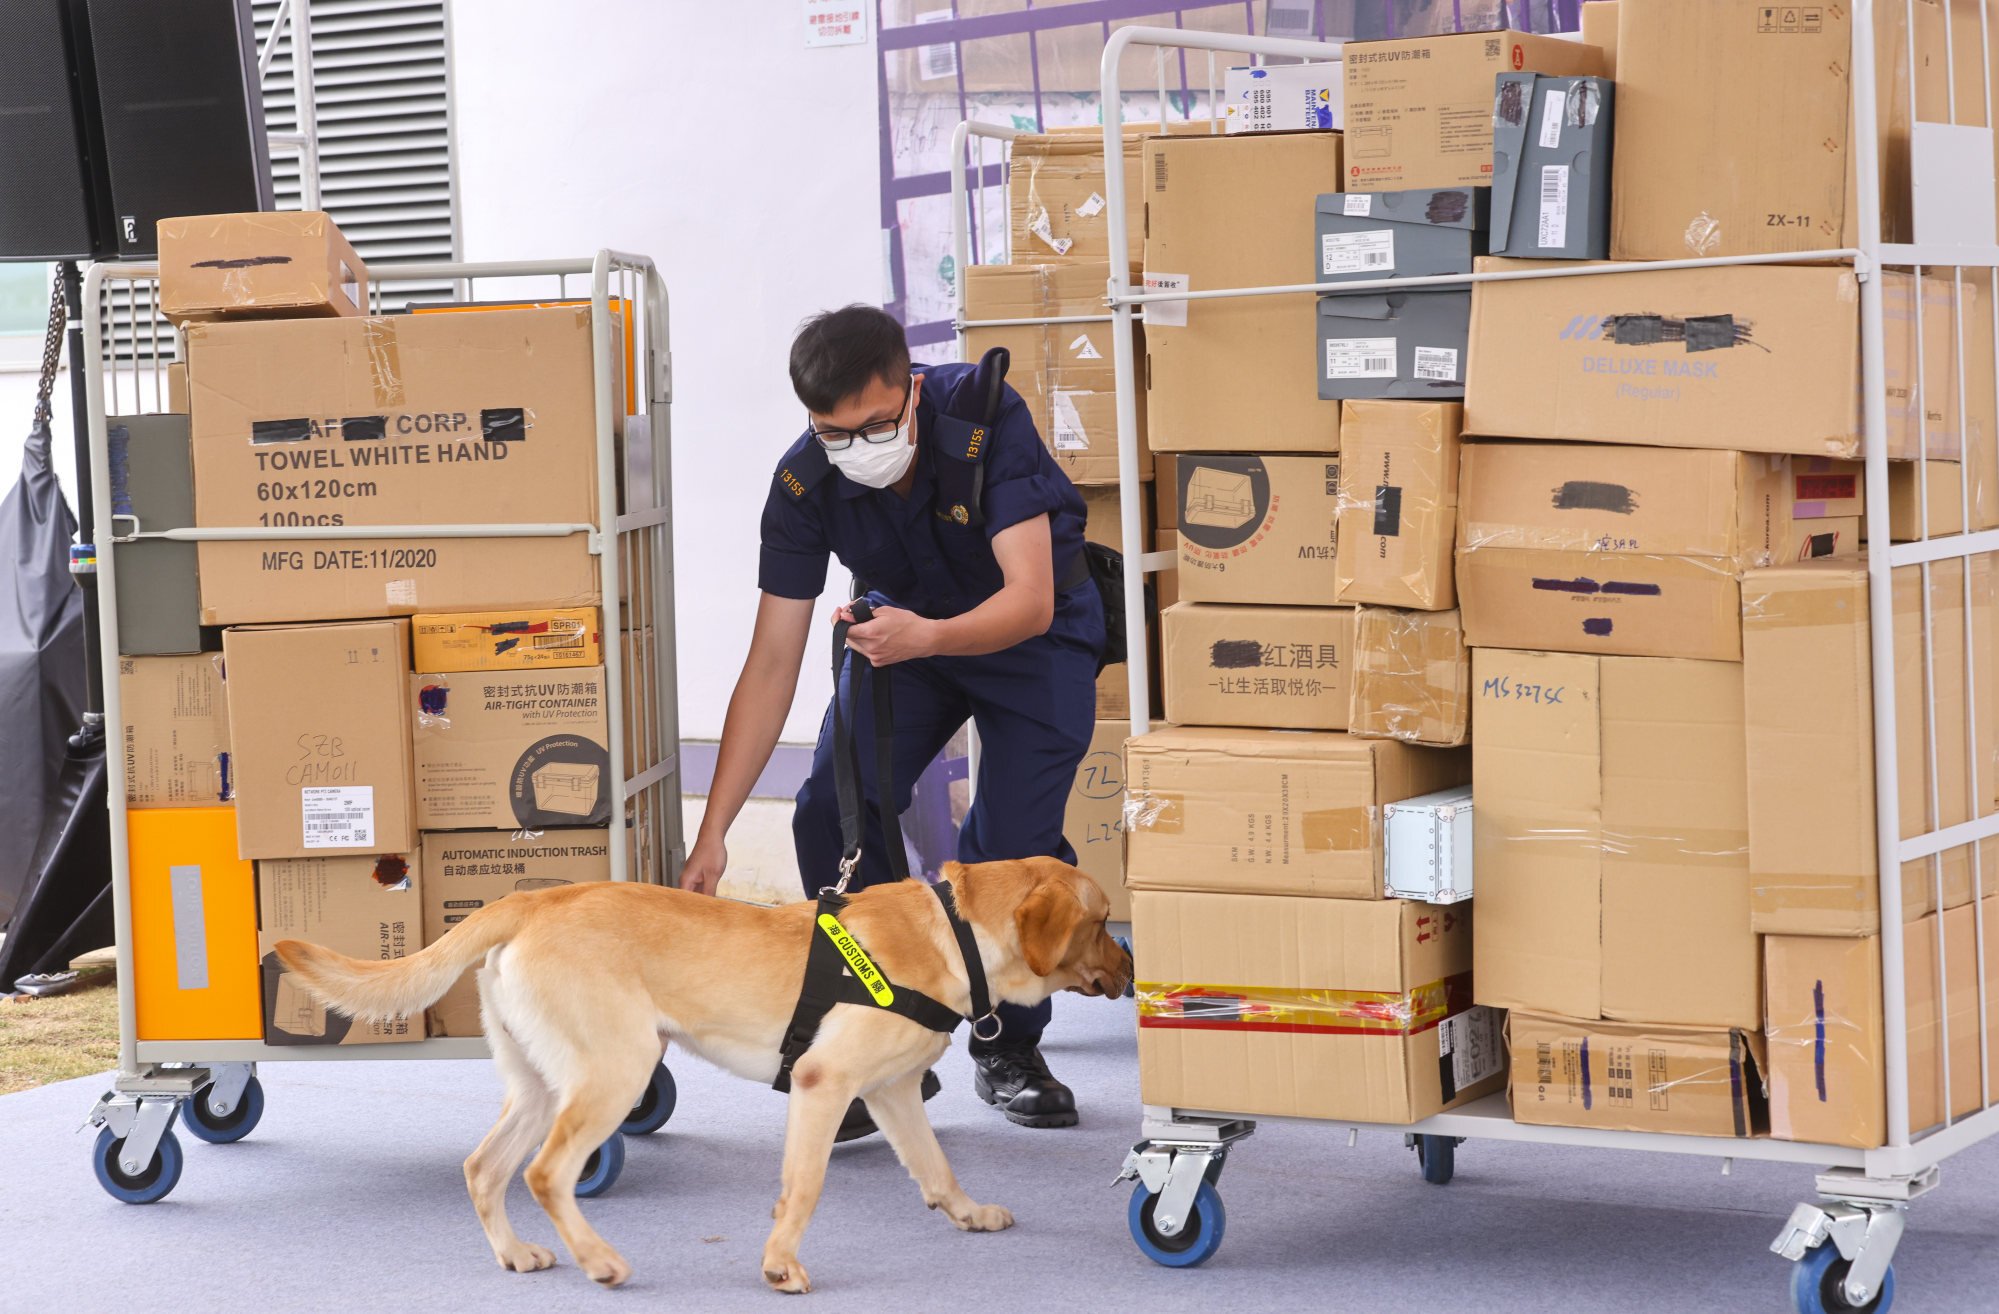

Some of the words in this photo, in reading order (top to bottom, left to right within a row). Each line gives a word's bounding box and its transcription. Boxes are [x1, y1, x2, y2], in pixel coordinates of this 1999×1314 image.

[1349, 48, 1431, 64] 密封式抗UV防潮箱
[1767, 214, 1810, 227] ZX-11
[1582, 356, 1657, 375] DELUXE
[1663, 359, 1718, 378] MASK
[1616, 383, 1681, 401] (Regular)
[397, 412, 472, 434] CORP.
[967, 428, 984, 459] 13155
[255, 449, 344, 471] TOWEL
[349, 445, 430, 466] WHITE
[438, 441, 508, 463] HAND
[257, 479, 377, 501] 60x120cm
[780, 469, 805, 496] 13155
[260, 511, 344, 527] 100pcs
[262, 551, 303, 571] MFG
[314, 549, 436, 570] DATE:11/2020
[1263, 643, 1339, 669] 红酒具
[483, 682, 597, 698] 密封式抗UV防潮箱
[485, 699, 536, 711] AIR-TIGHT
[539, 697, 597, 709] CONTAINER
[522, 711, 541, 719] with
[542, 710, 554, 718] UV
[556, 708, 597, 718] Protection
[536, 745, 545, 755] UV
[546, 740, 578, 749] Protection
[442, 848, 505, 861] AUTOMATIC
[507, 847, 568, 859] INDUCTION
[571, 845, 607, 857] TRASH
[444, 863, 525, 876] 自动感应垃圾桶
[837, 936, 875, 980] CUSTOMS
